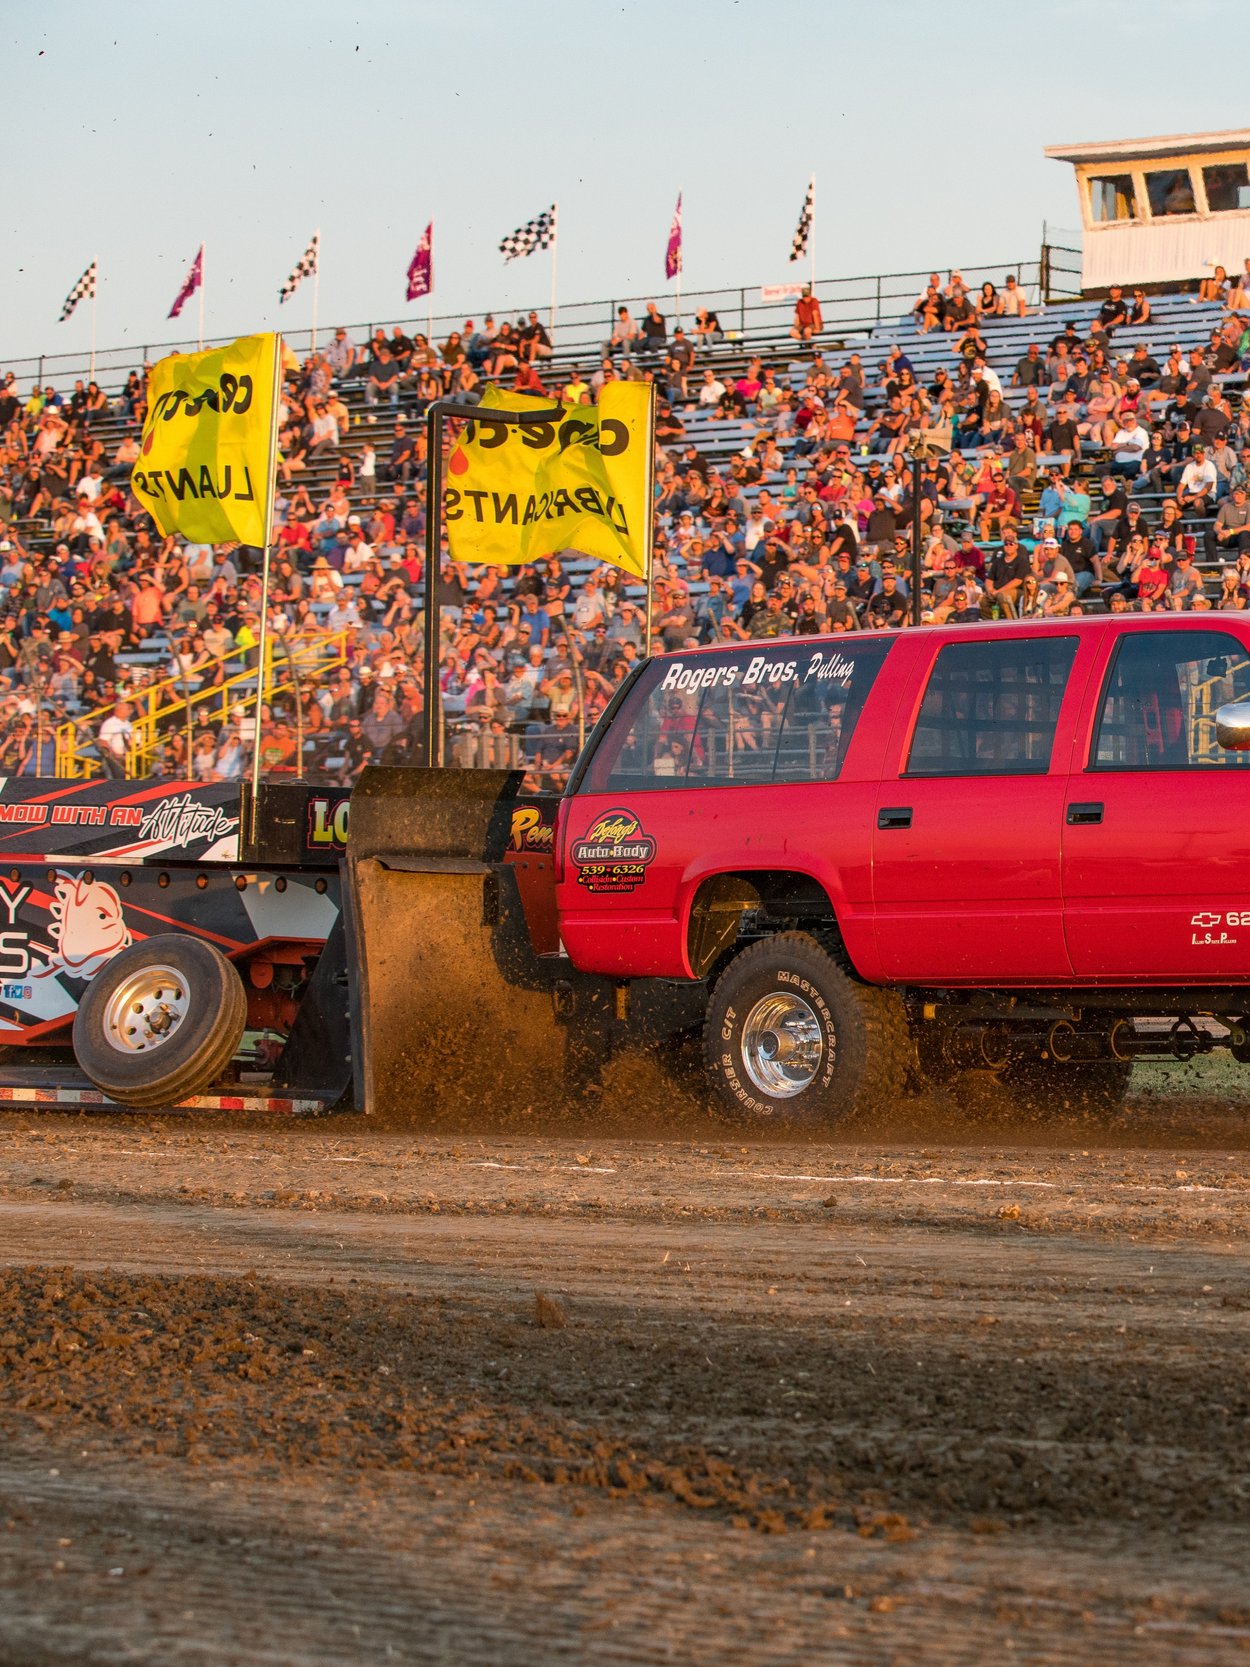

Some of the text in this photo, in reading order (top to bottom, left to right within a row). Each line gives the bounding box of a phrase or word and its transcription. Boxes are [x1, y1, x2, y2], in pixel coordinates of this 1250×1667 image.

[660, 652, 856, 695] Rogers Bros. Pulling
[50, 804, 107, 825] WITH
[109, 807, 143, 826] AN
[138, 794, 236, 848] Attitude
[578, 845, 649, 859] Auto Body
[581, 864, 645, 875] 539 6326
[582, 874, 644, 884] Collision Custom
[593, 883, 634, 891] Restoration
[777, 970, 837, 1088] MASTERCRAFT
[721, 1052, 774, 1116] COURSER
